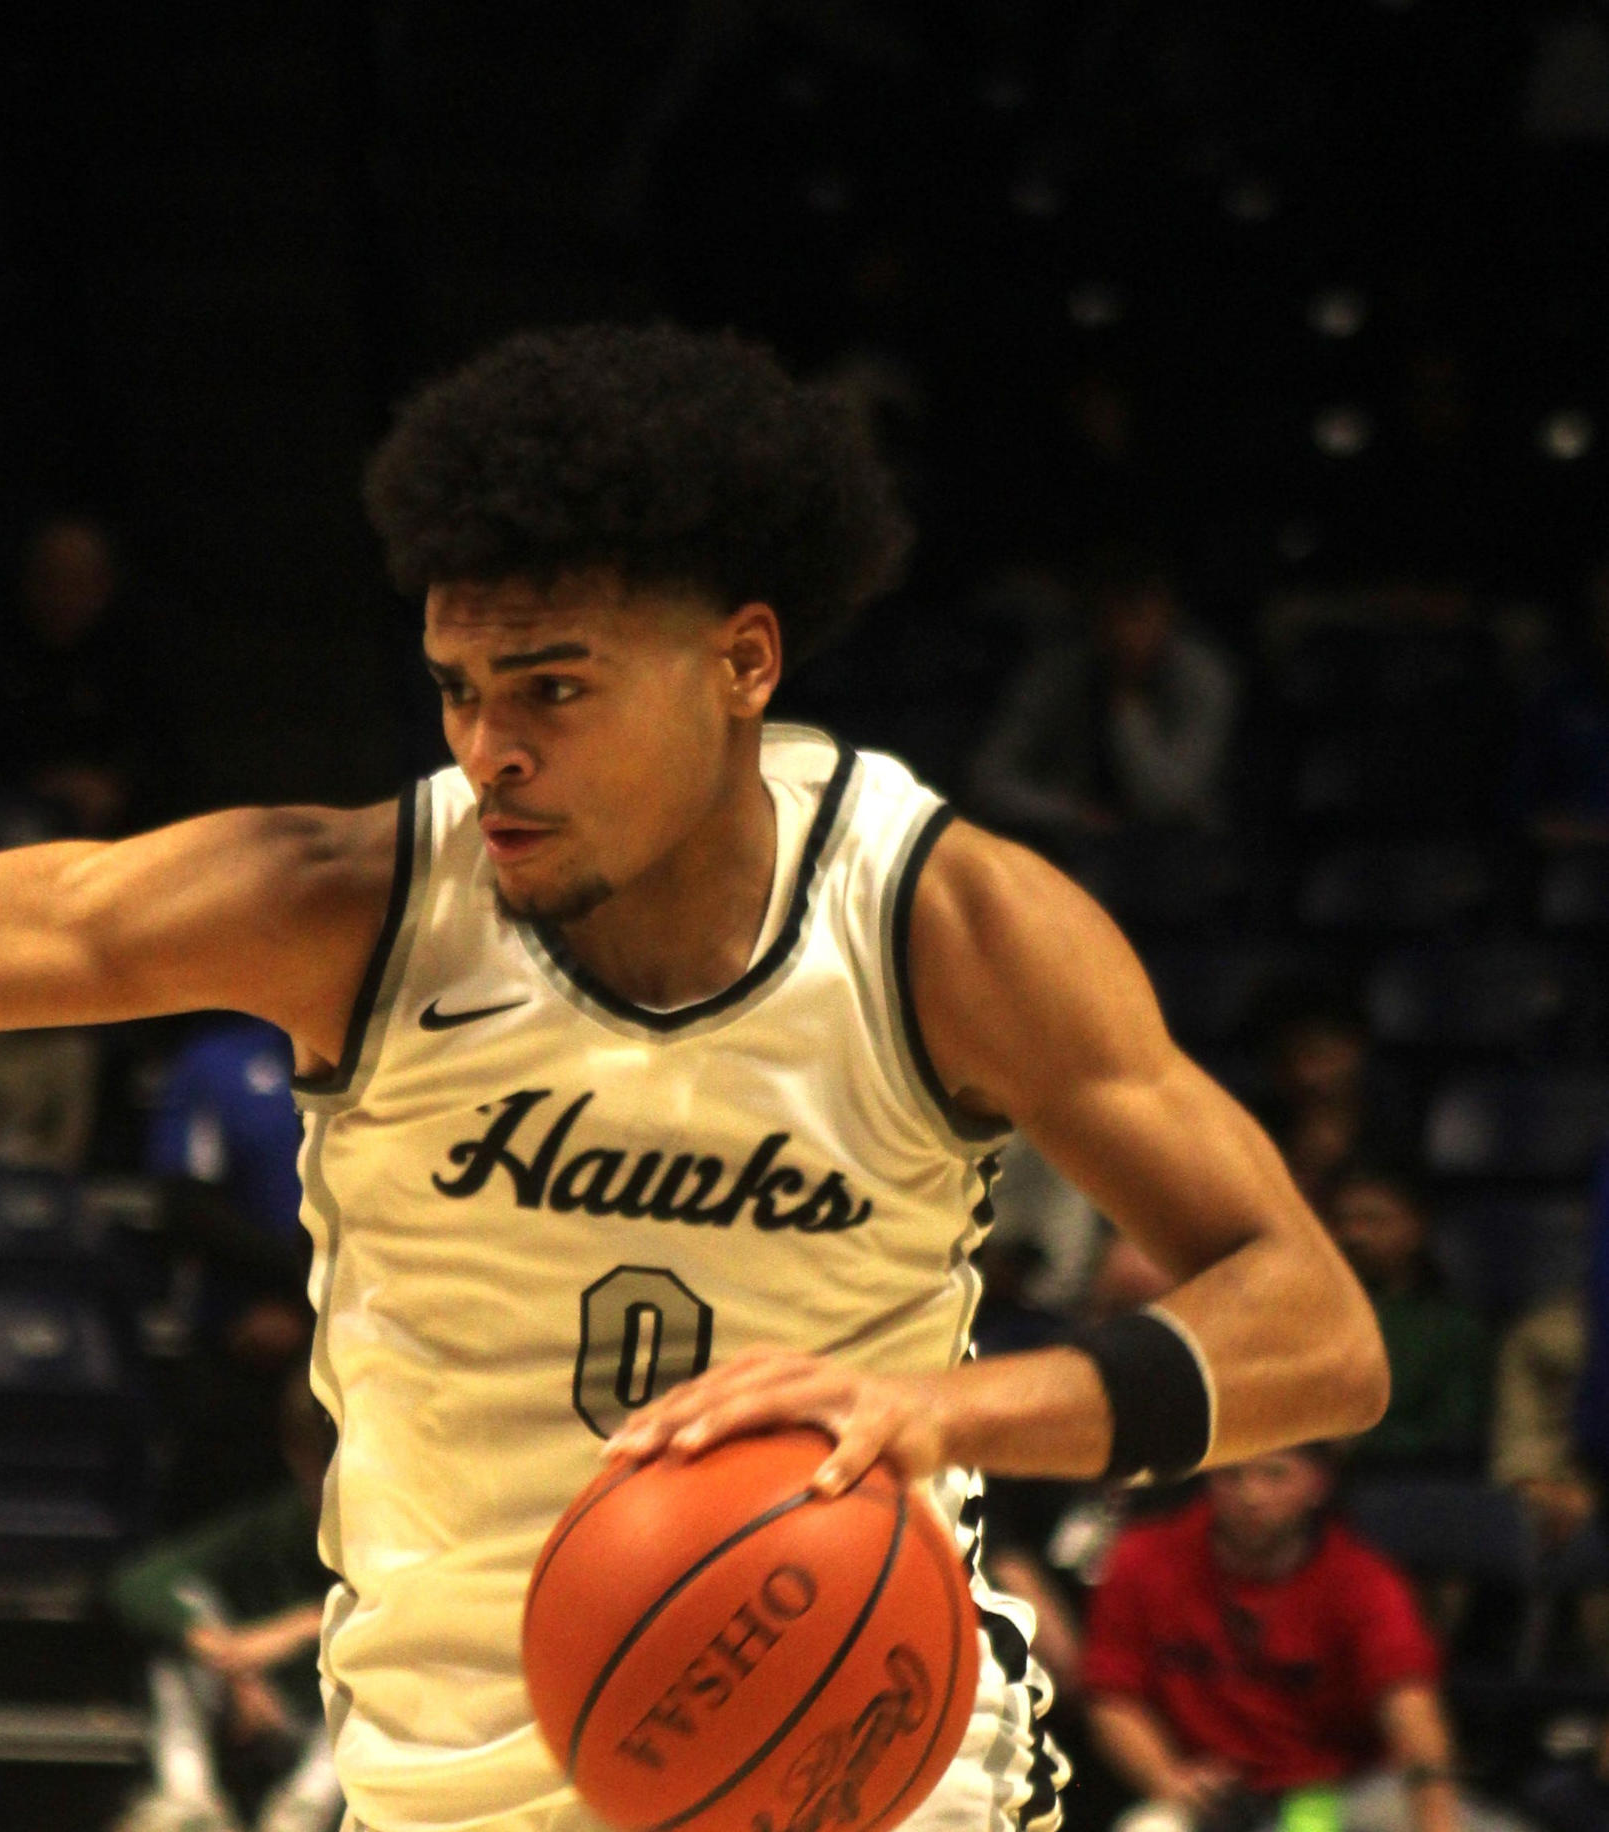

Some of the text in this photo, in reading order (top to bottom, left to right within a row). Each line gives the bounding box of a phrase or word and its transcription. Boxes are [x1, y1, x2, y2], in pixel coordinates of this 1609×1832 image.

[431, 1088, 873, 1233] Hawks
[572, 1264, 713, 1441] 0
[615, 1562, 819, 1770] OHSAA
